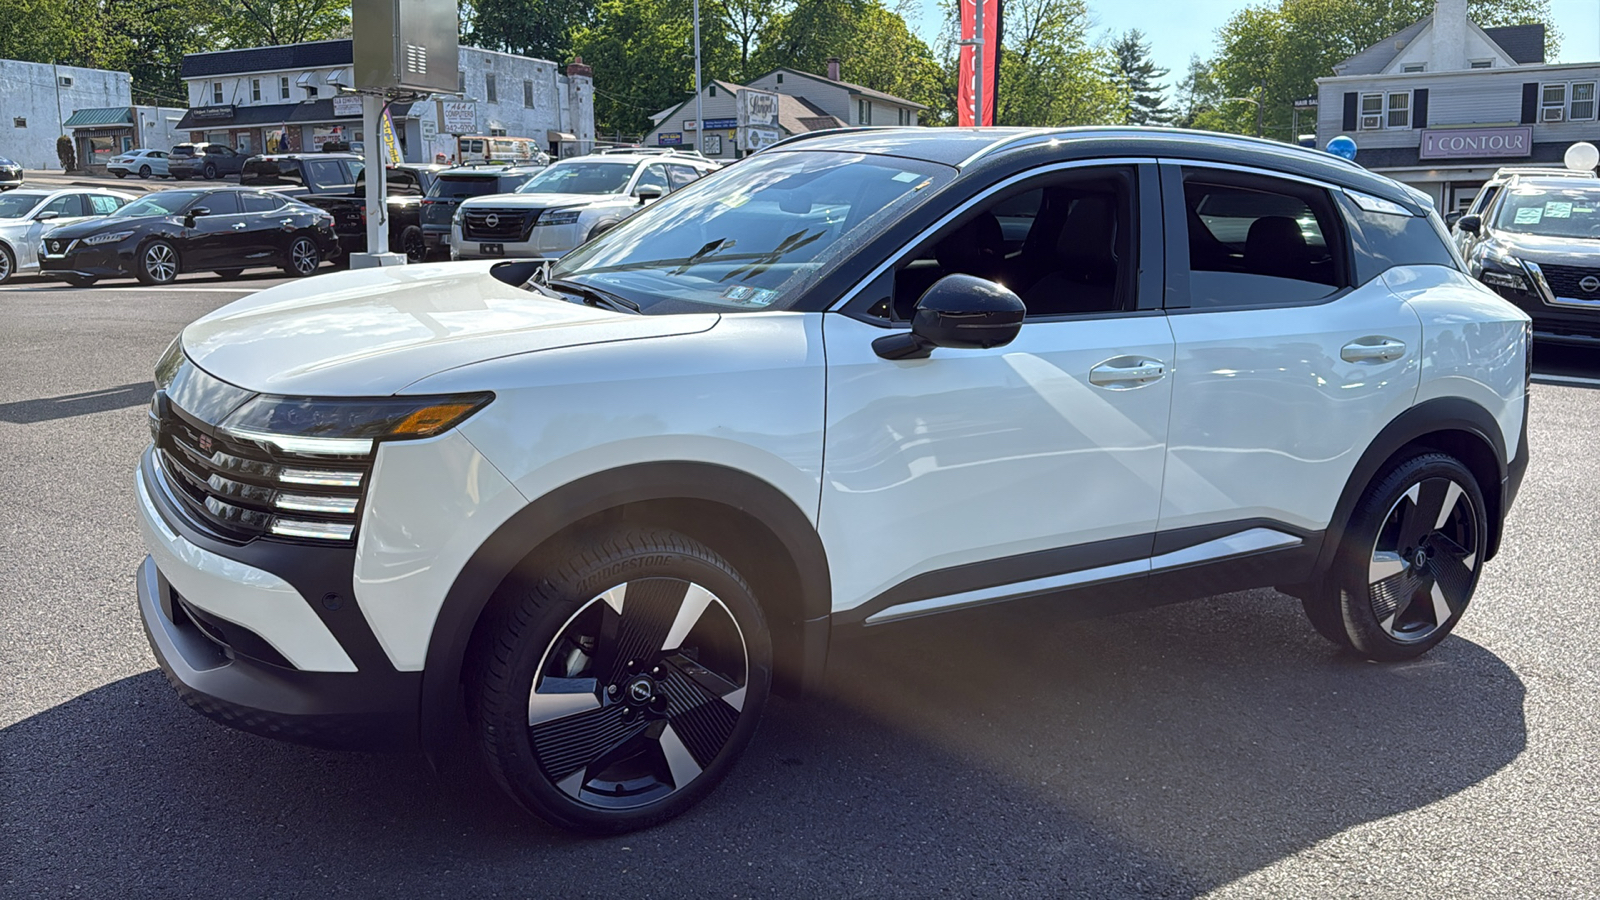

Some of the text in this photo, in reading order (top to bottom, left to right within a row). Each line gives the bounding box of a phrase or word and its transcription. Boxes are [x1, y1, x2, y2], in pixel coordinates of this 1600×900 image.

[445, 110, 474, 118] COMPUTERS
[1438, 135, 1523, 151] CONTOUR
[576, 555, 673, 593] BRIDGESTONE
